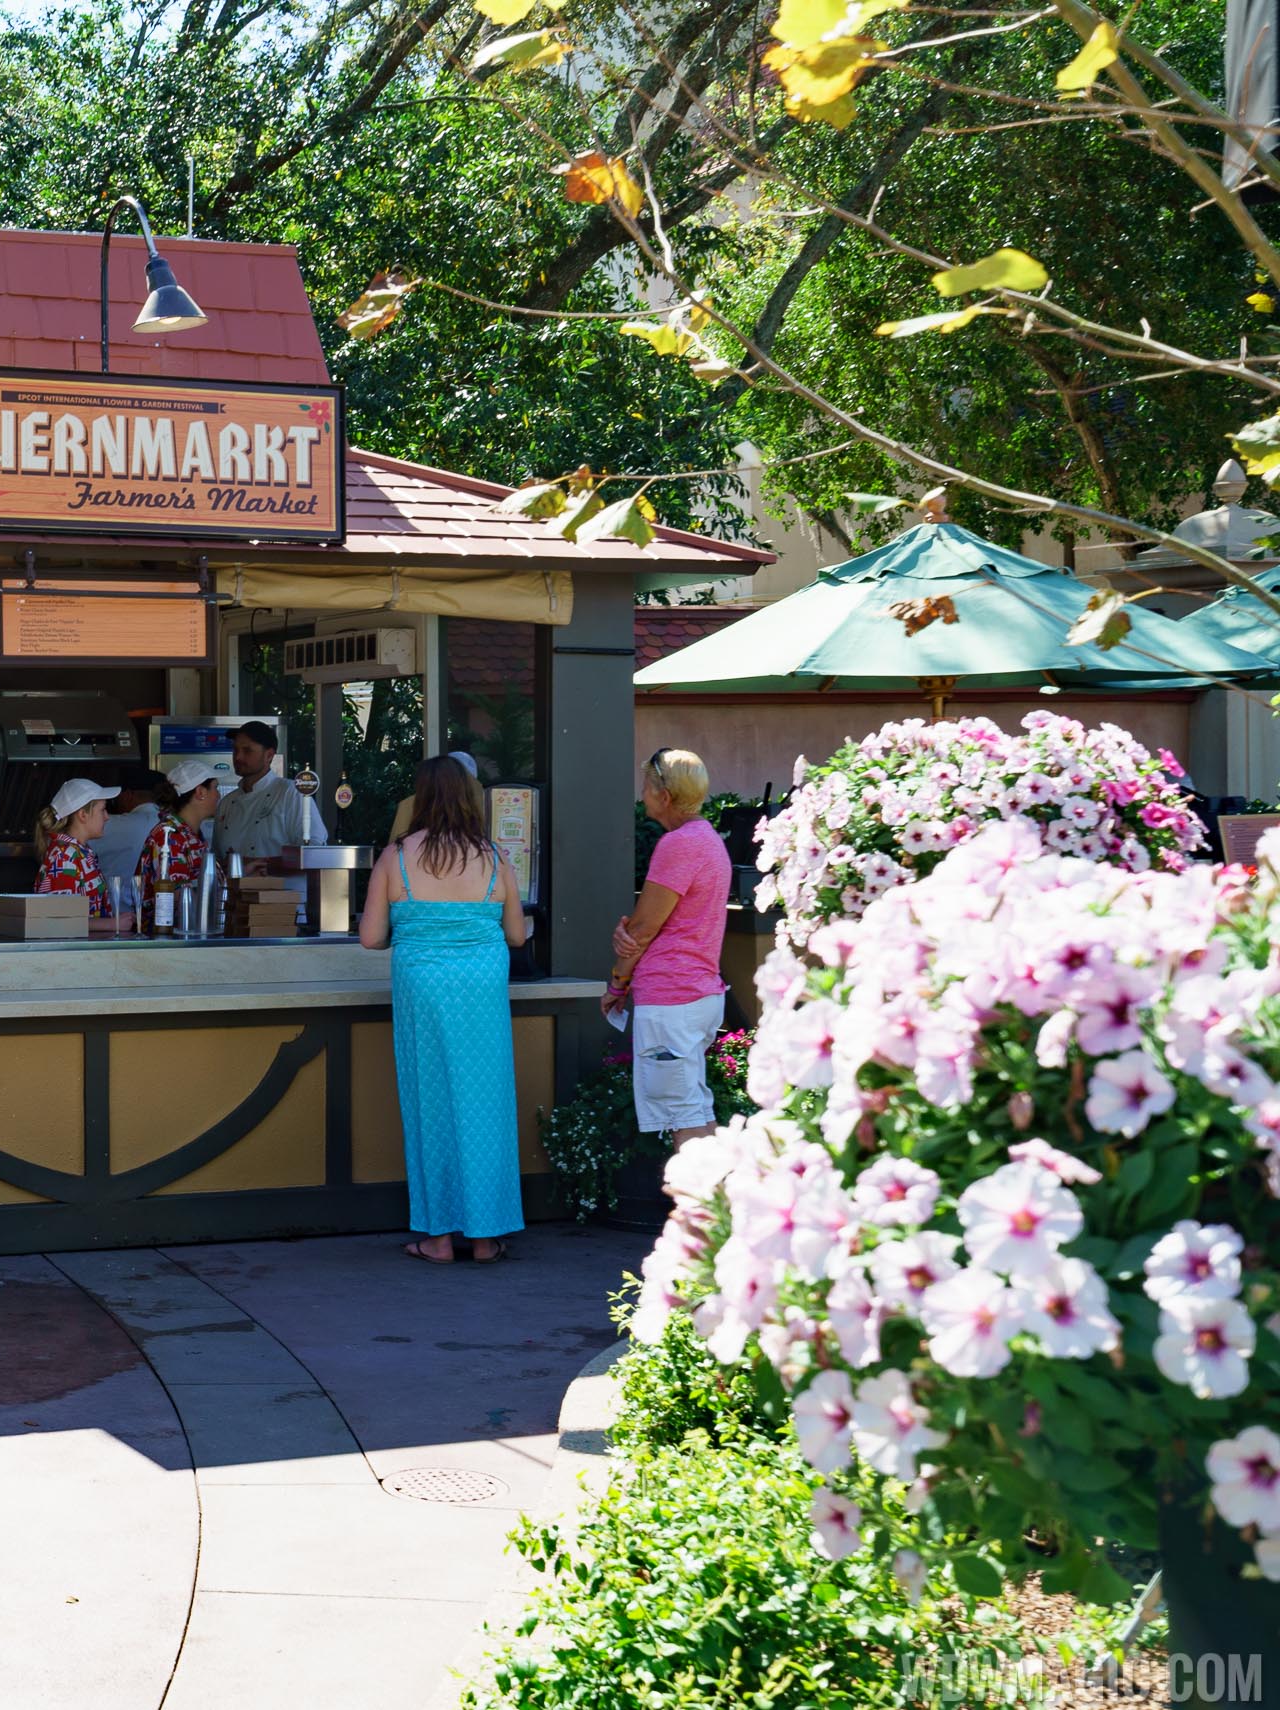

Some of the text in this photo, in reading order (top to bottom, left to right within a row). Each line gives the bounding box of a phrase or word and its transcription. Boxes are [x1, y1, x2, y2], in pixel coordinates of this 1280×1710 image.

[18, 393, 41, 402] EPCOT
[44, 395, 101, 405] INTERNATIONAL
[103, 398, 132, 407] FLOWER
[142, 401, 171, 409] GARDEN
[173, 402, 204, 411] FESTIVAL
[68, 481, 319, 515] Farmer's Market
